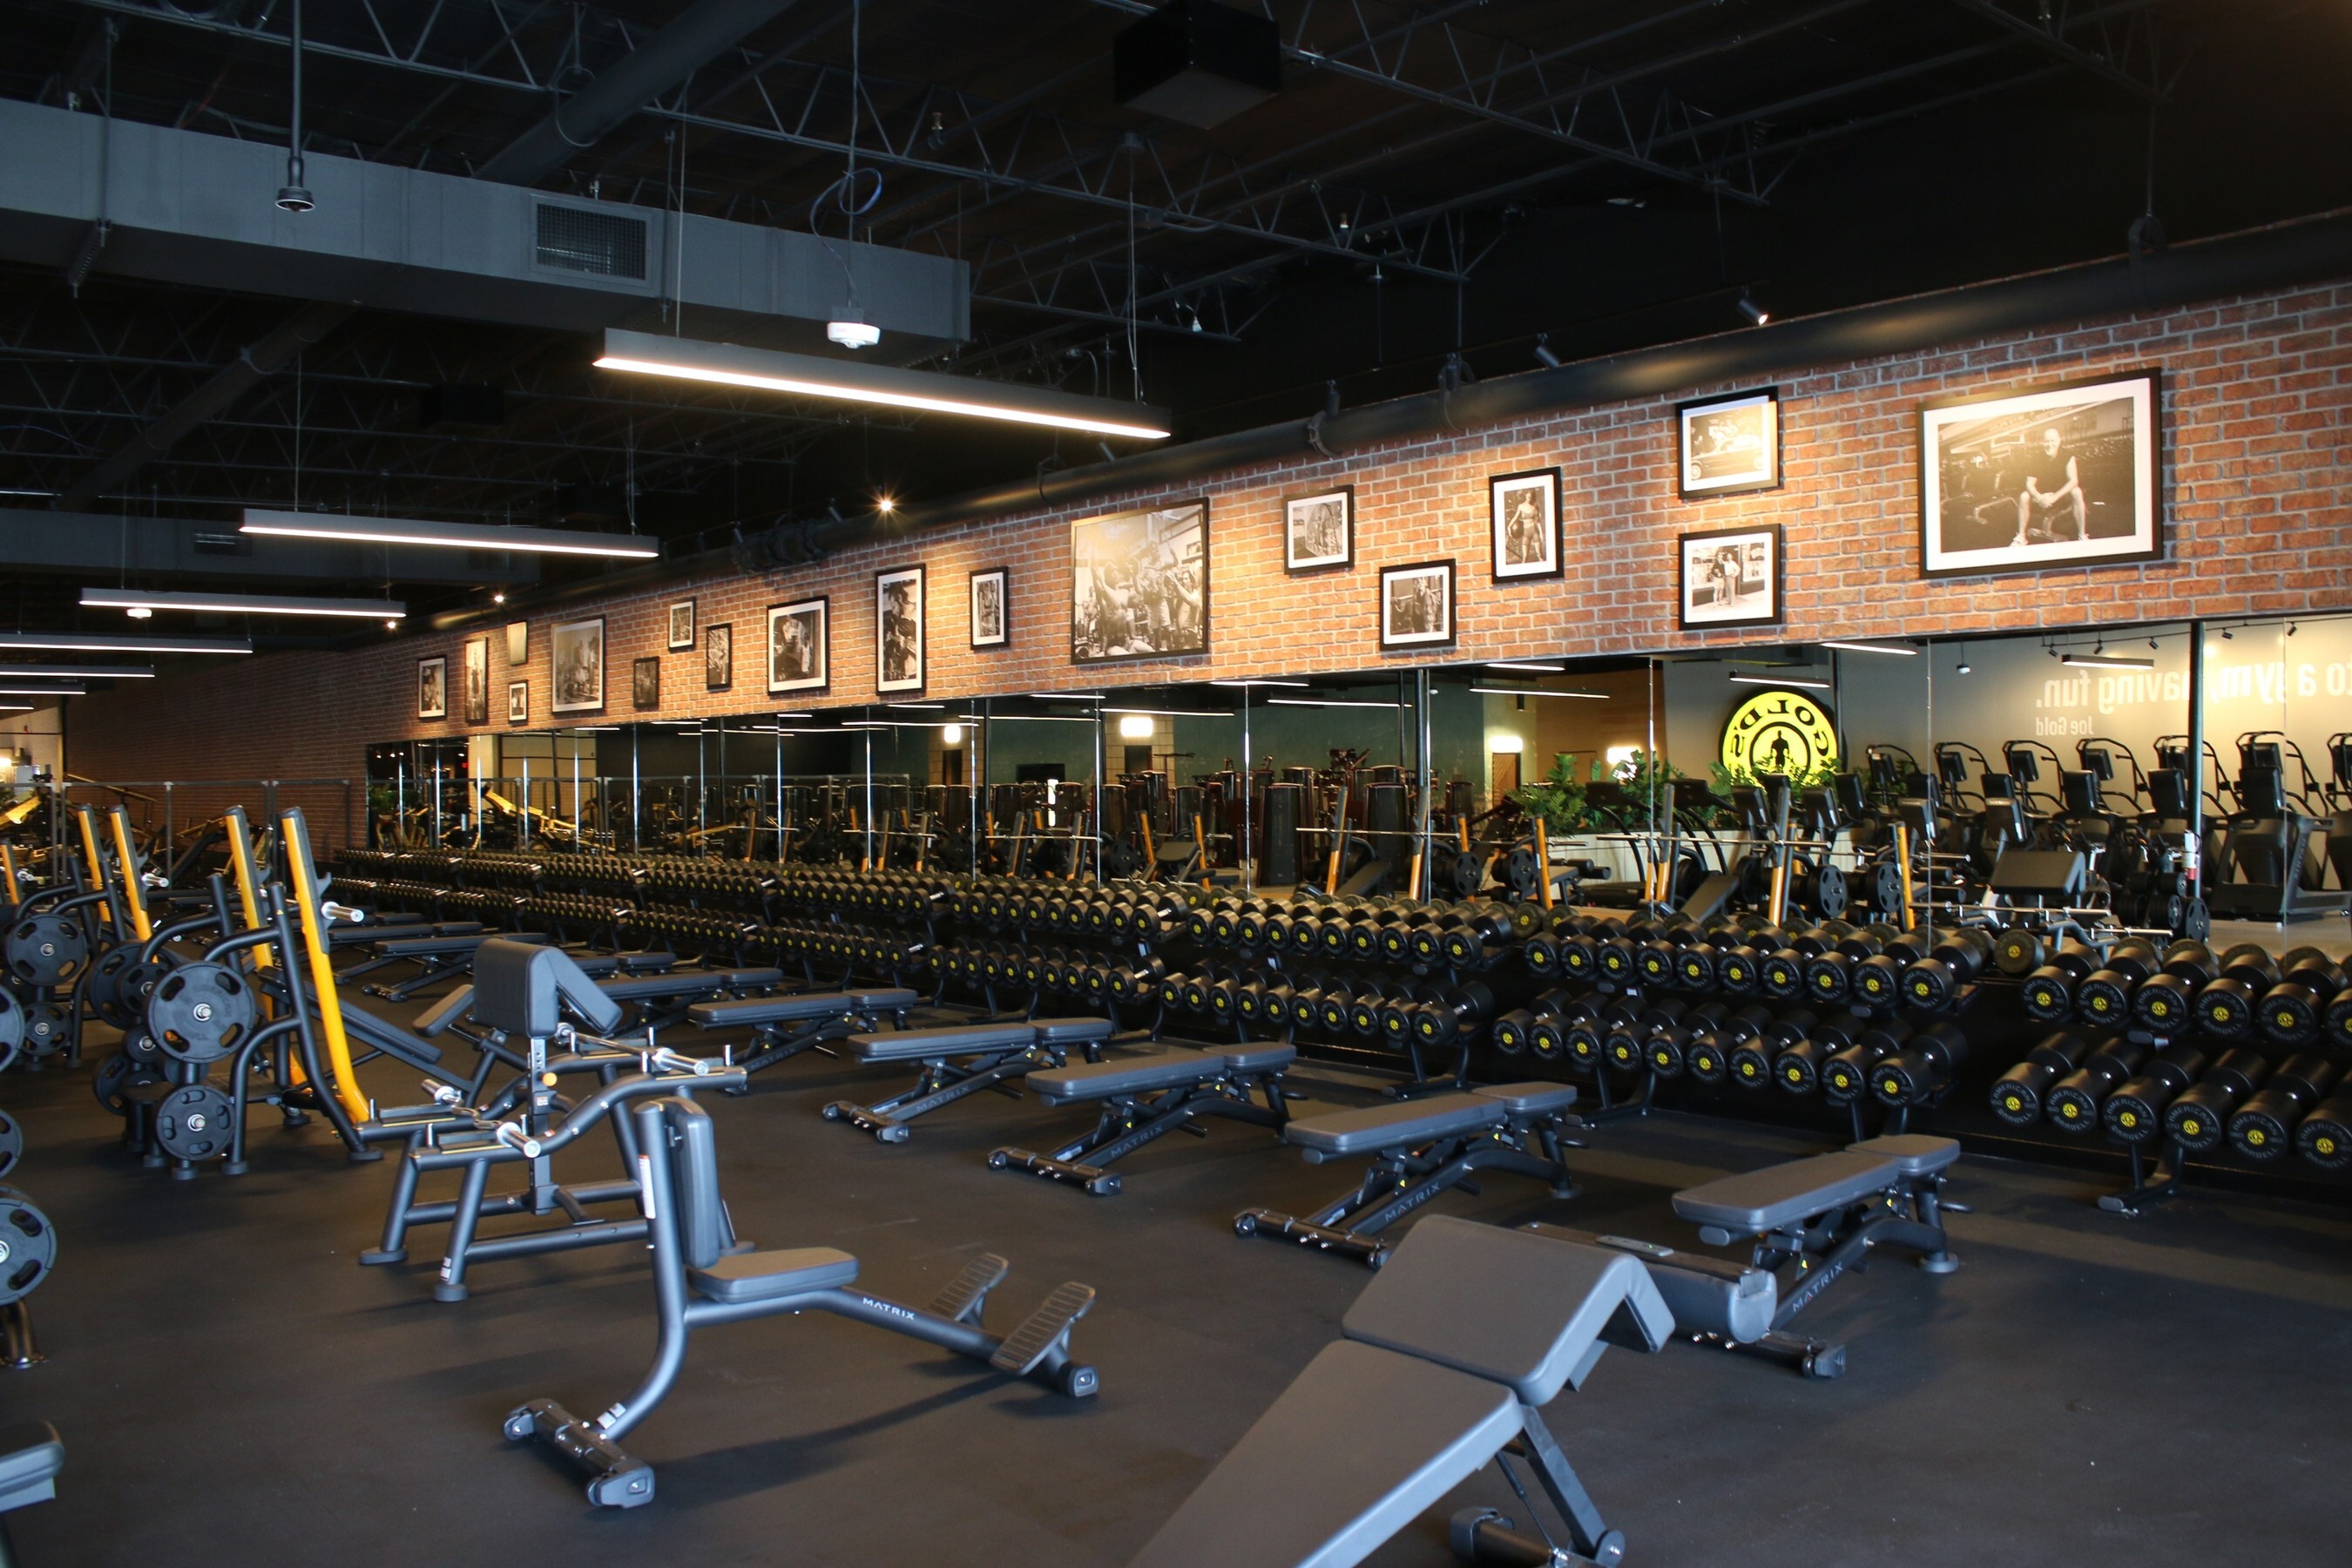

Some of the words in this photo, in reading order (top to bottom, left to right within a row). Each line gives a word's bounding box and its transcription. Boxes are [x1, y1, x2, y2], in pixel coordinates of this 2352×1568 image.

[916, 1085, 970, 1113] MATRIX
[1111, 1125, 1163, 1158] MATRIX
[1384, 1182, 1440, 1221] MATRIX
[1793, 1261, 1843, 1313] MATRIX
[862, 1297, 915, 1321] MATRIX
